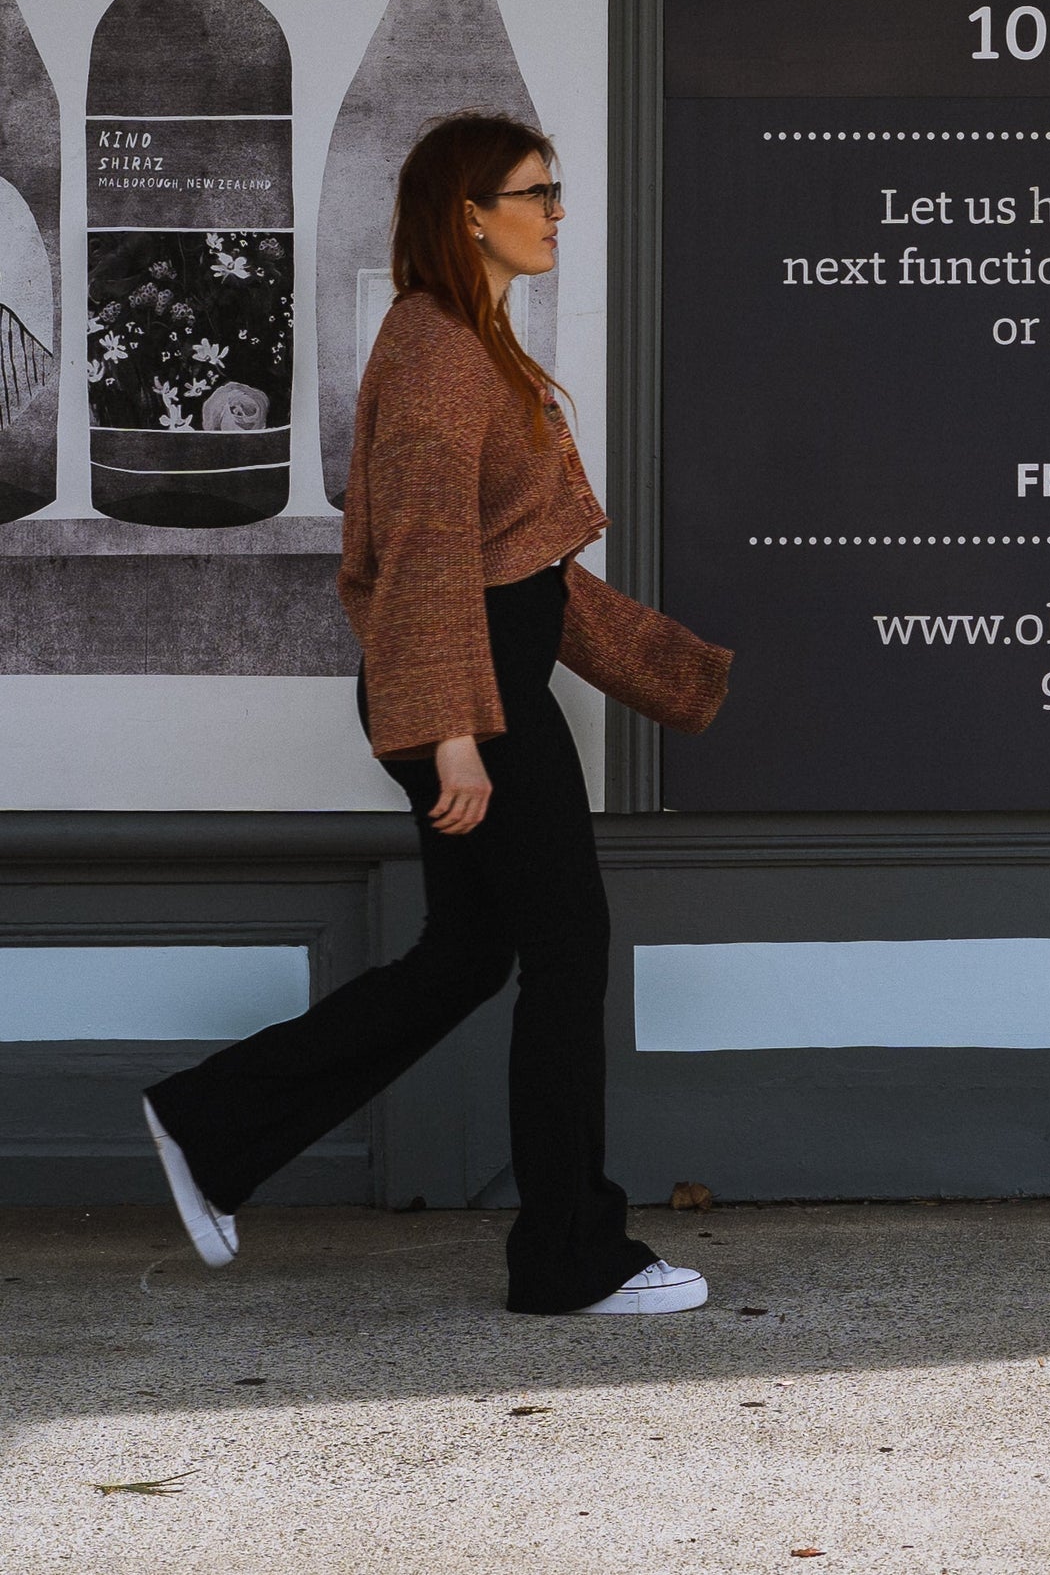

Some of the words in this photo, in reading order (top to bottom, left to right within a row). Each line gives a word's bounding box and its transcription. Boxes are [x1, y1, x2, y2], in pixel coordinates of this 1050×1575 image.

[98, 156, 164, 171] SHIRAZ
[98, 177, 183, 192] MALBOROUGH,
[186, 178, 215, 189] NEW
[218, 179, 272, 190] ZEALAND
[881, 190, 953, 224] Let
[964, 197, 1016, 224] us
[783, 252, 886, 285] next
[993, 318, 1040, 345] or
